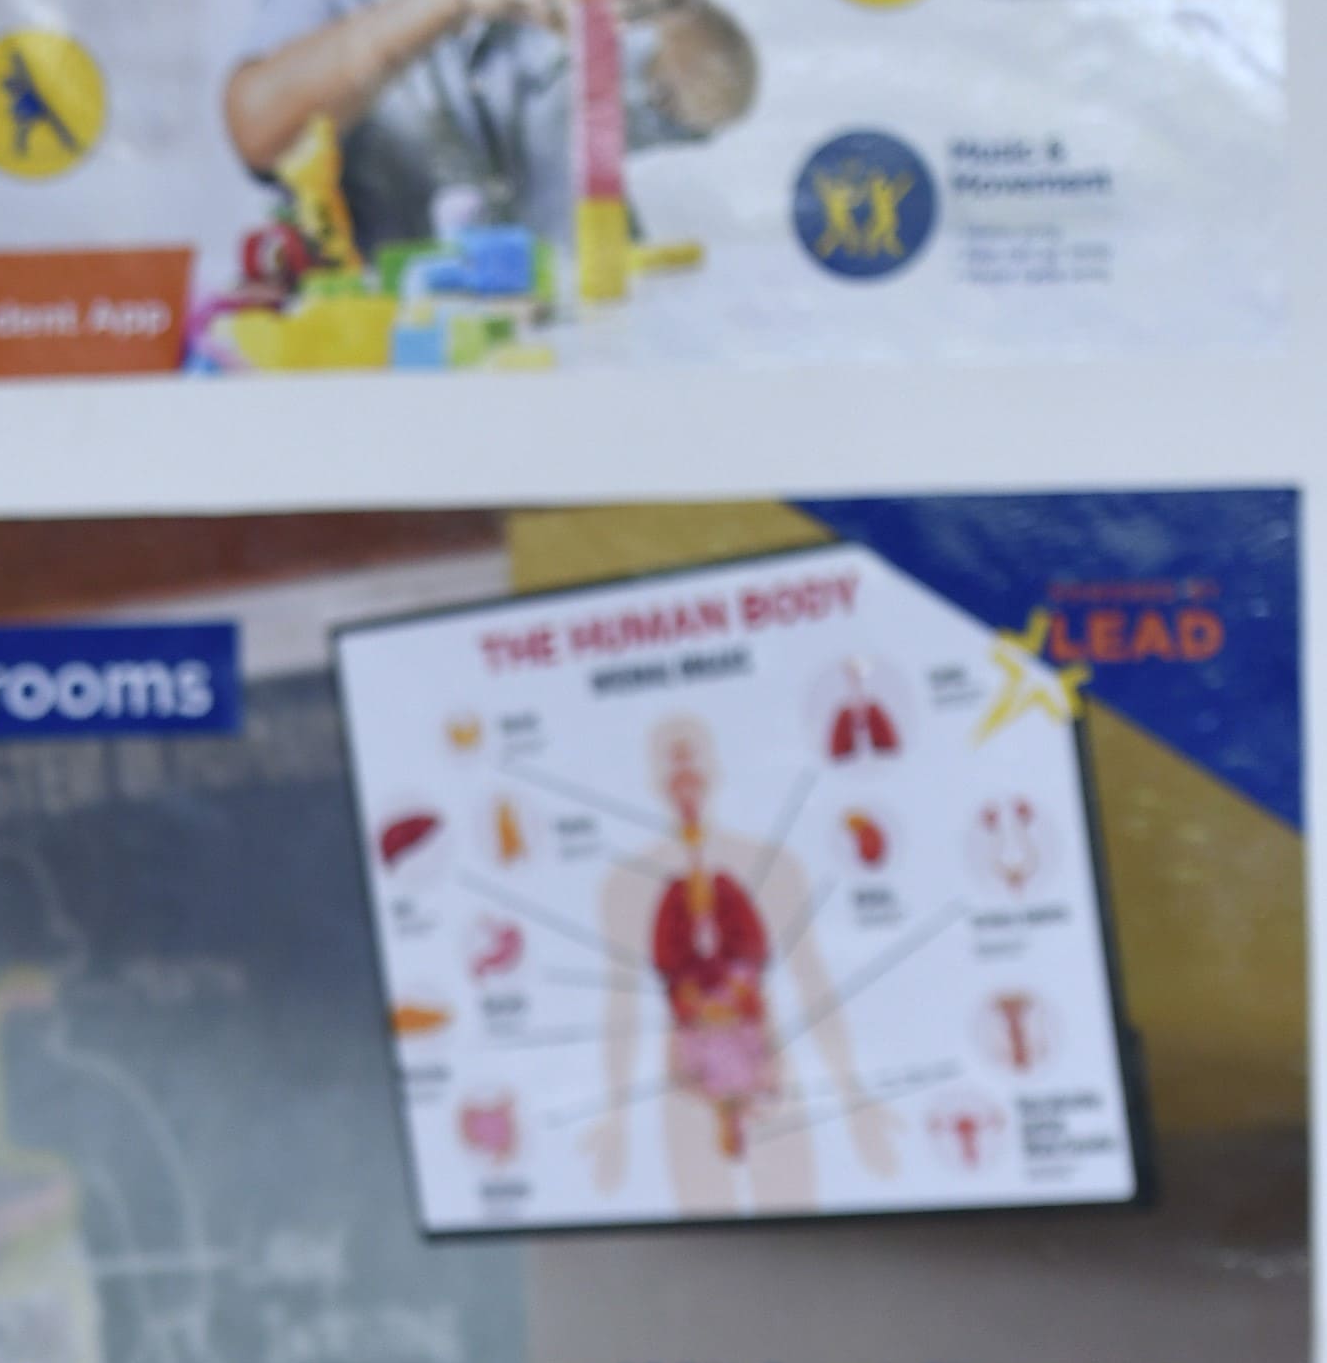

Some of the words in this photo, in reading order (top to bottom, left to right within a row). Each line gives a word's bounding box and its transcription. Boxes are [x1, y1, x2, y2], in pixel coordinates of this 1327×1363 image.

[87, 296, 171, 336] App
[480, 628, 555, 675] THE
[569, 599, 729, 657] HUMAN
[737, 570, 860, 630] BODY
[1050, 608, 1225, 664] LEAD
